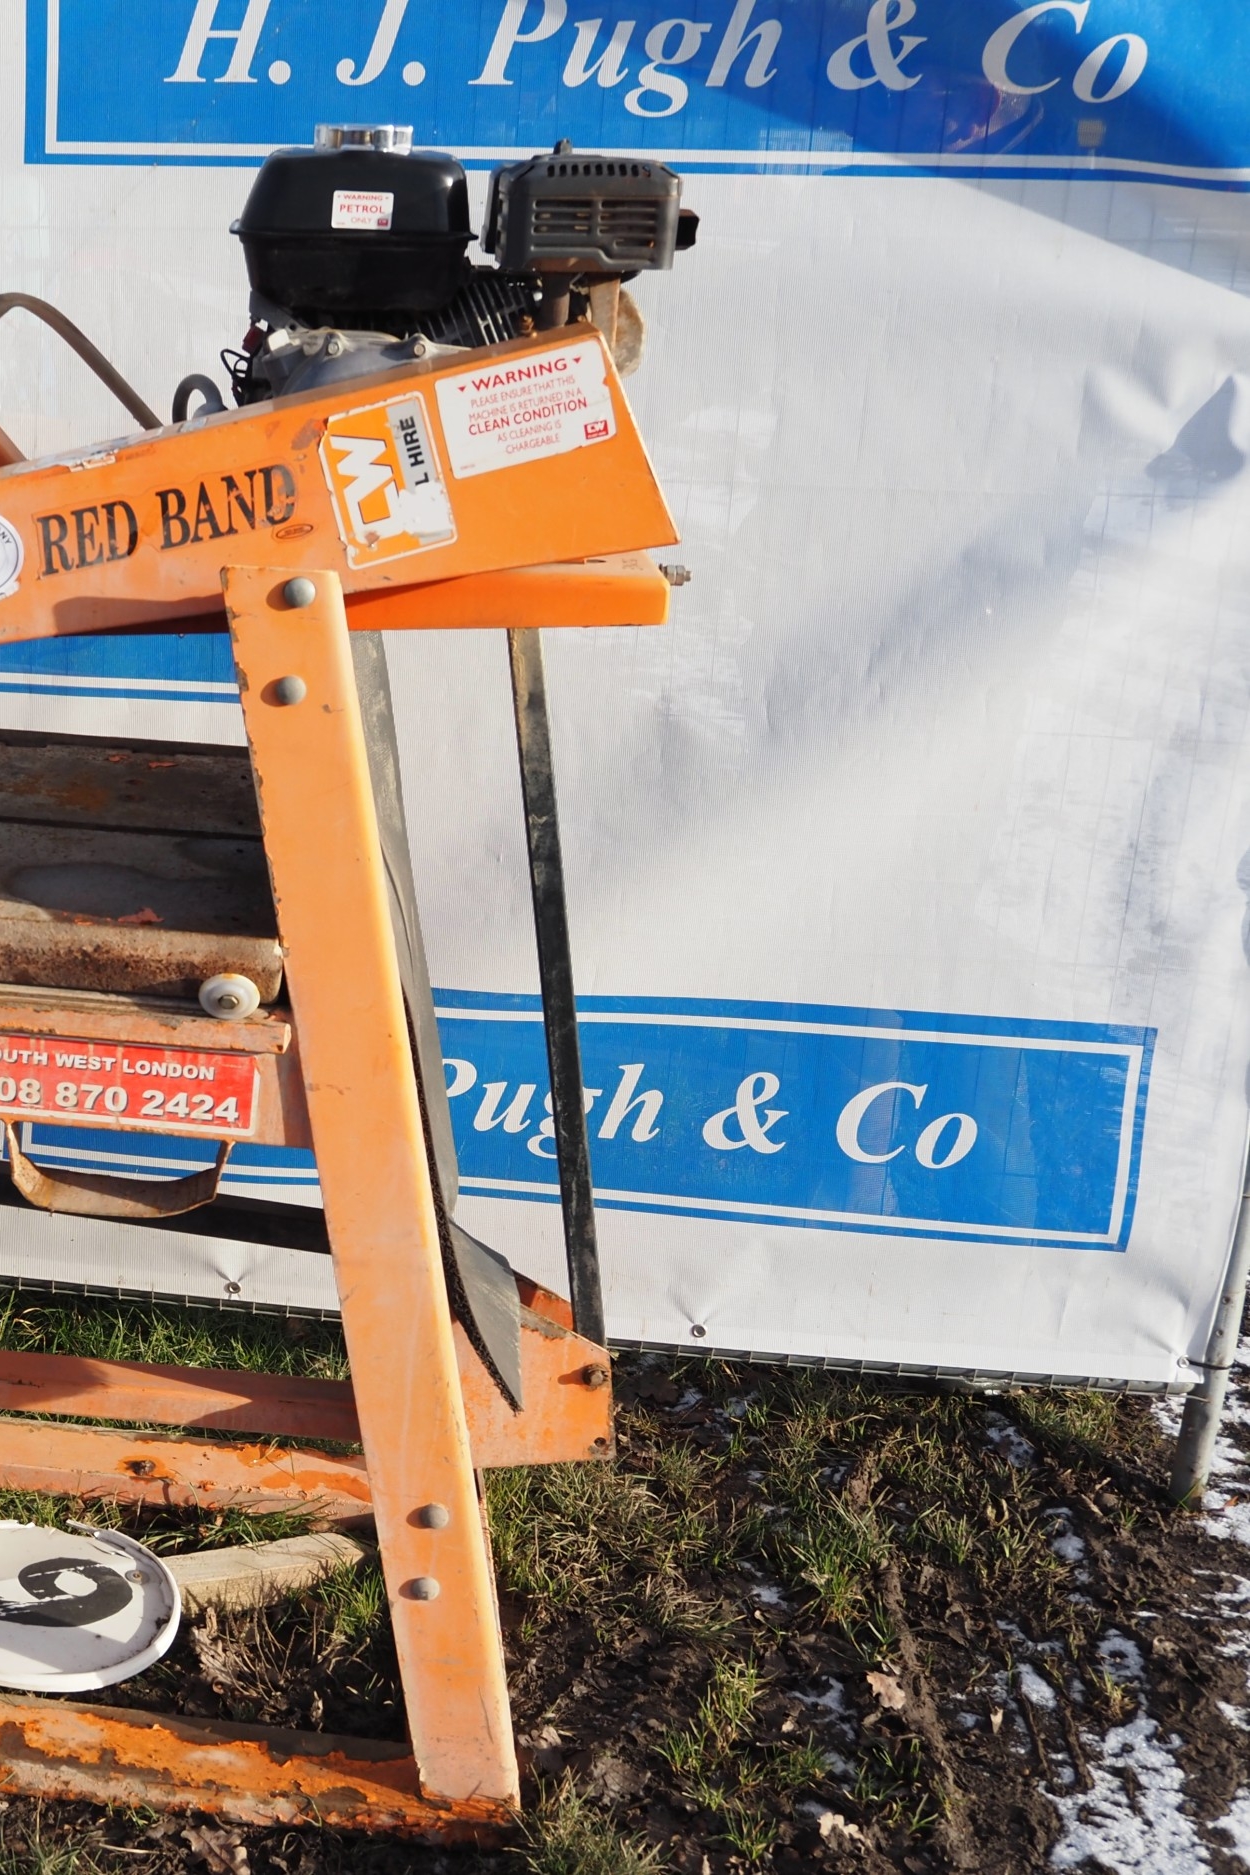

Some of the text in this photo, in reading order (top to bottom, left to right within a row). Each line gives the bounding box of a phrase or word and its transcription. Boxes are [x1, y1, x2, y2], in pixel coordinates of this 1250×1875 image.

[163, 0, 1148, 119] H. J. Pugh & Co
[339, 204, 385, 214] PETROL
[351, 217, 372, 225] ONLY
[470, 374, 576, 409] PLEASE ENSURE THAT THIS
[471, 358, 568, 391] WARNING
[468, 387, 583, 422] MACHINE IS RETURNED IN A
[468, 396, 588, 436] CLEAN CONDITION
[399, 415, 425, 469] HIRE
[497, 419, 562, 443] AS CLEANING IS
[505, 433, 561, 455] CHARGEABLE
[36, 463, 296, 577] RED BAND
[54, 1053, 117, 1072] WEST
[122, 1058, 215, 1082] LONDON
[54, 1082, 128, 1113] 870
[141, 1089, 239, 1123] 2424
[702, 1071, 790, 1155] &
[836, 1081, 978, 1170] Co
